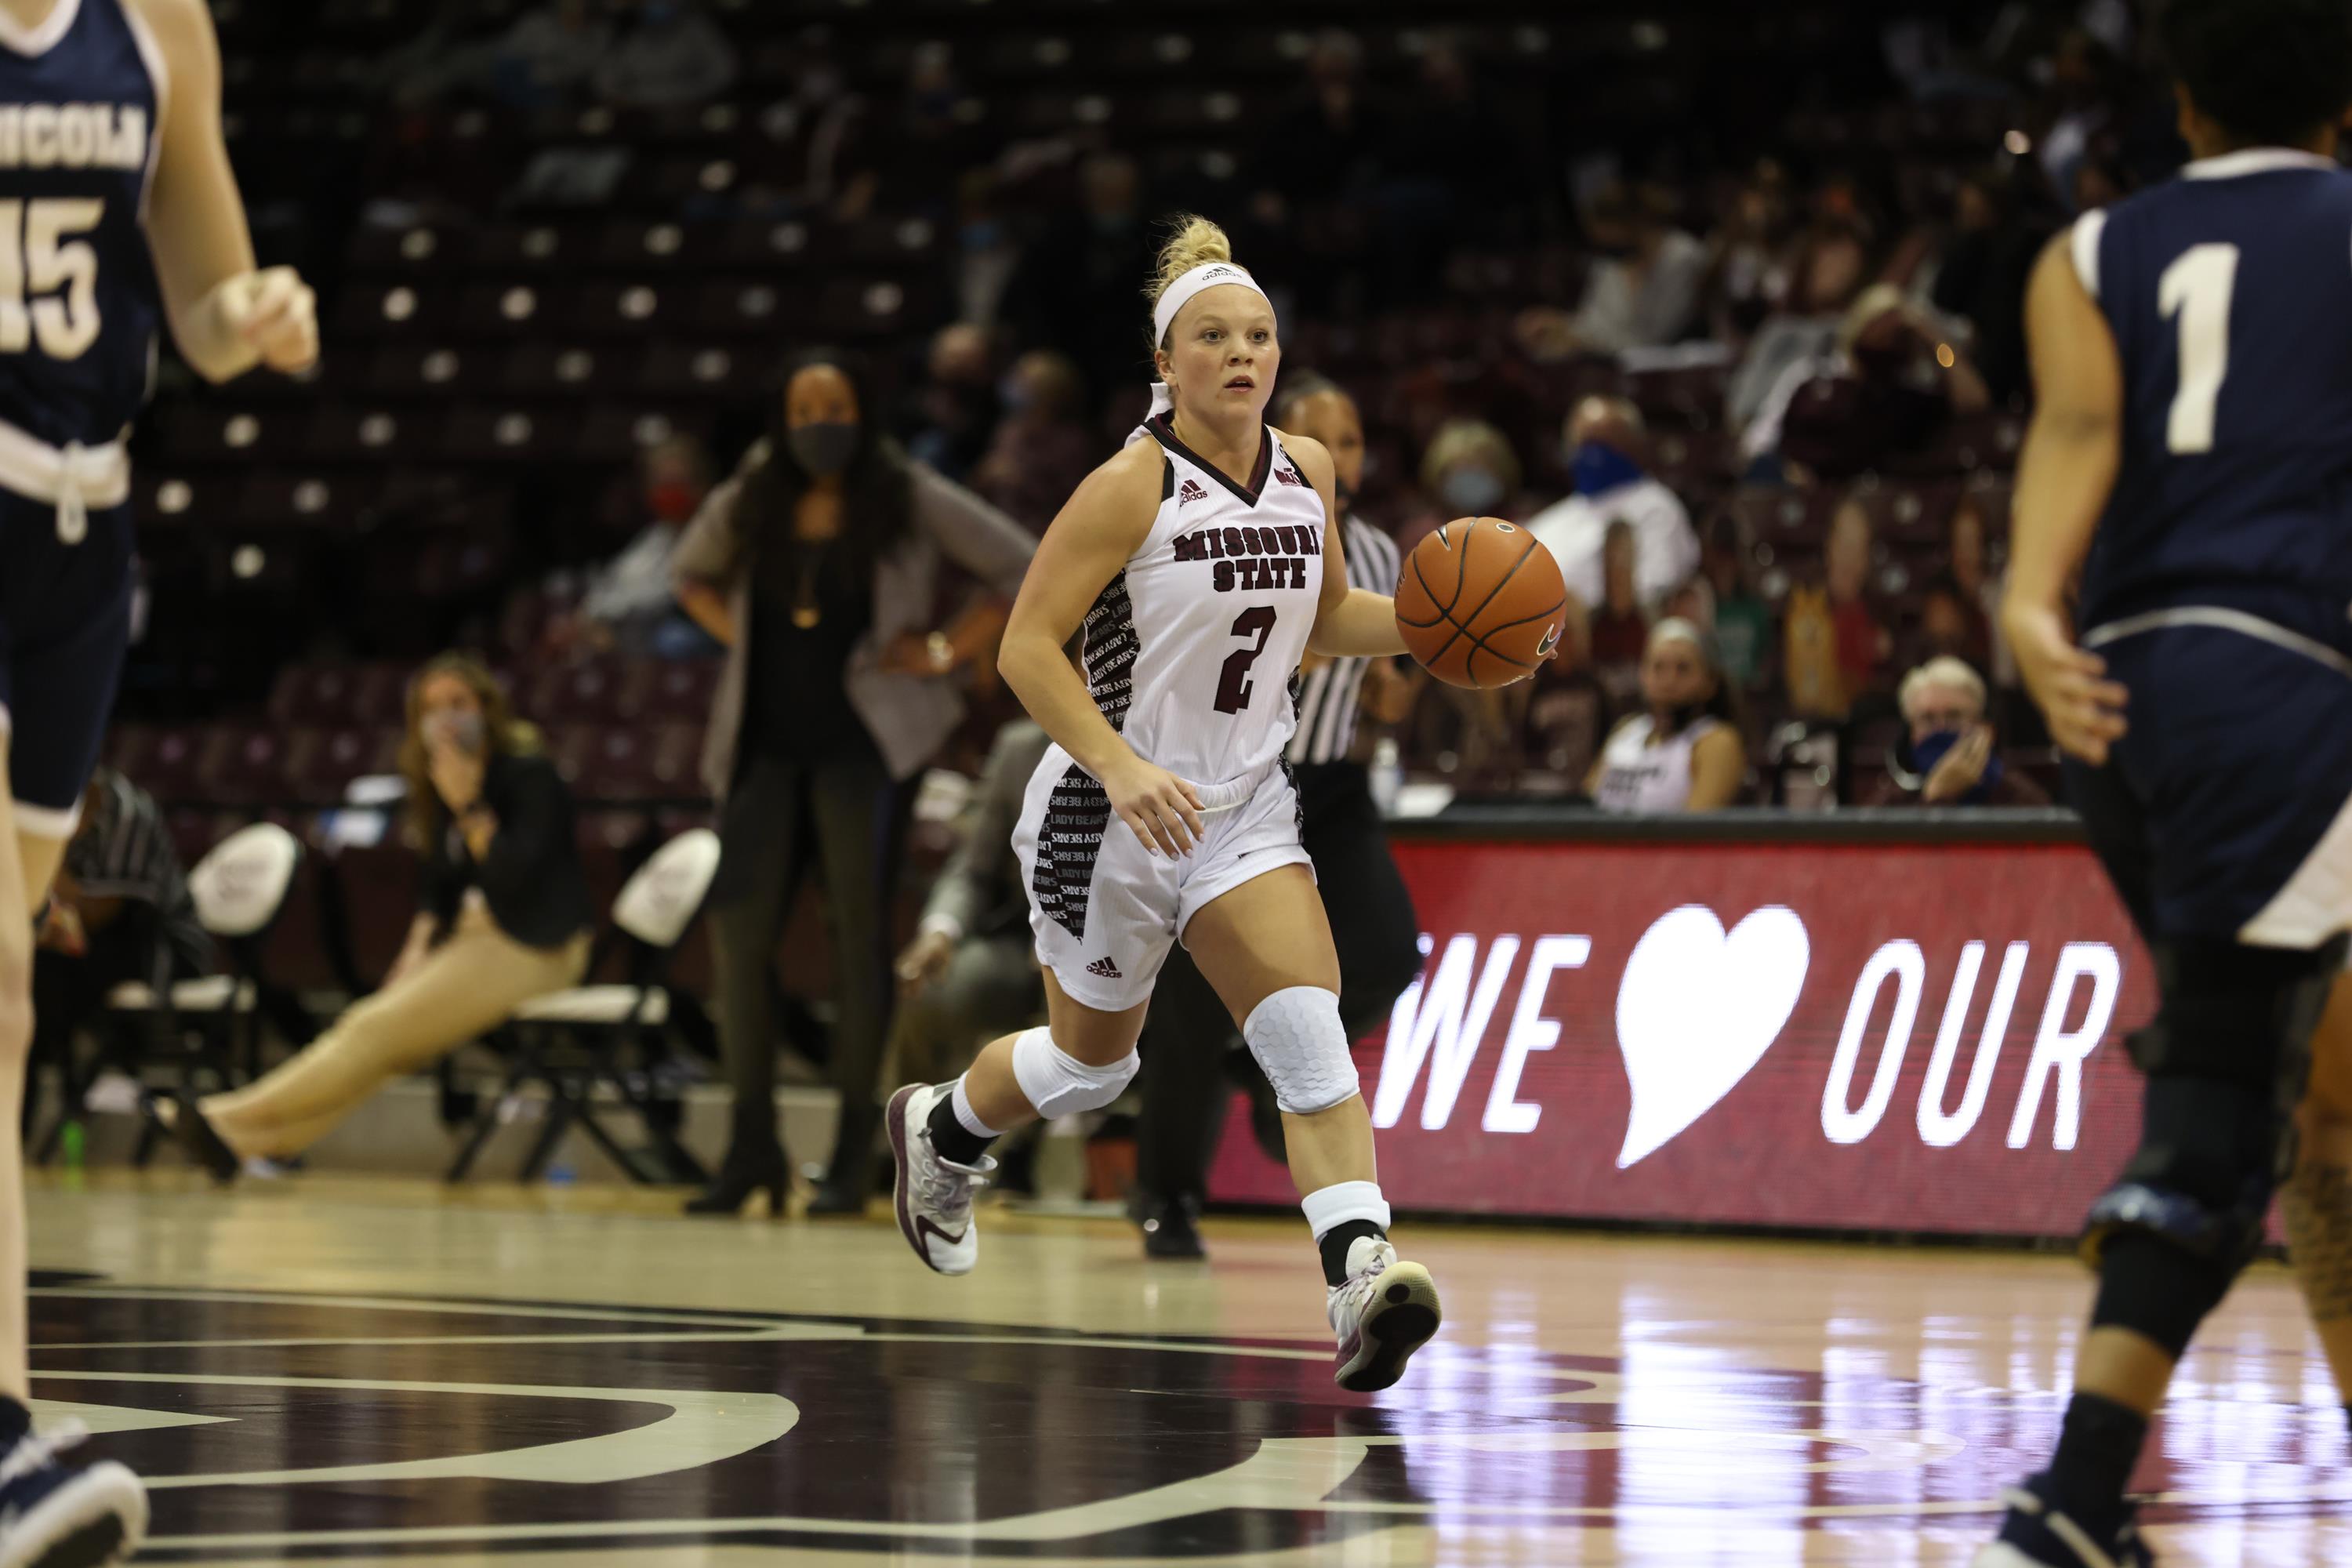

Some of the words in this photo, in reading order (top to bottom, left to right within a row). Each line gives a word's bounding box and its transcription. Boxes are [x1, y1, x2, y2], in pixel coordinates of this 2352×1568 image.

[1202, 270, 1242, 281] adidas
[2158, 242, 2240, 454] 1
[1179, 490, 1208, 507] adidas
[1173, 525, 1320, 562] MISSOURI
[1213, 557, 1306, 593] STATE
[1105, 647, 1137, 671] BEARS
[1213, 605, 1277, 715] 2
[1051, 795, 1083, 808] BEARS
[1051, 814, 1075, 825] LADY
[1075, 813, 1110, 826] BEARS
[1051, 833, 1083, 844] BEARS
[1052, 851, 1086, 862] BEARS
[1055, 868, 1080, 879] LADY
[1086, 965, 1123, 978] adidas
[1371, 932, 1592, 1134] WE
[1820, 938, 2122, 1152] OUR
